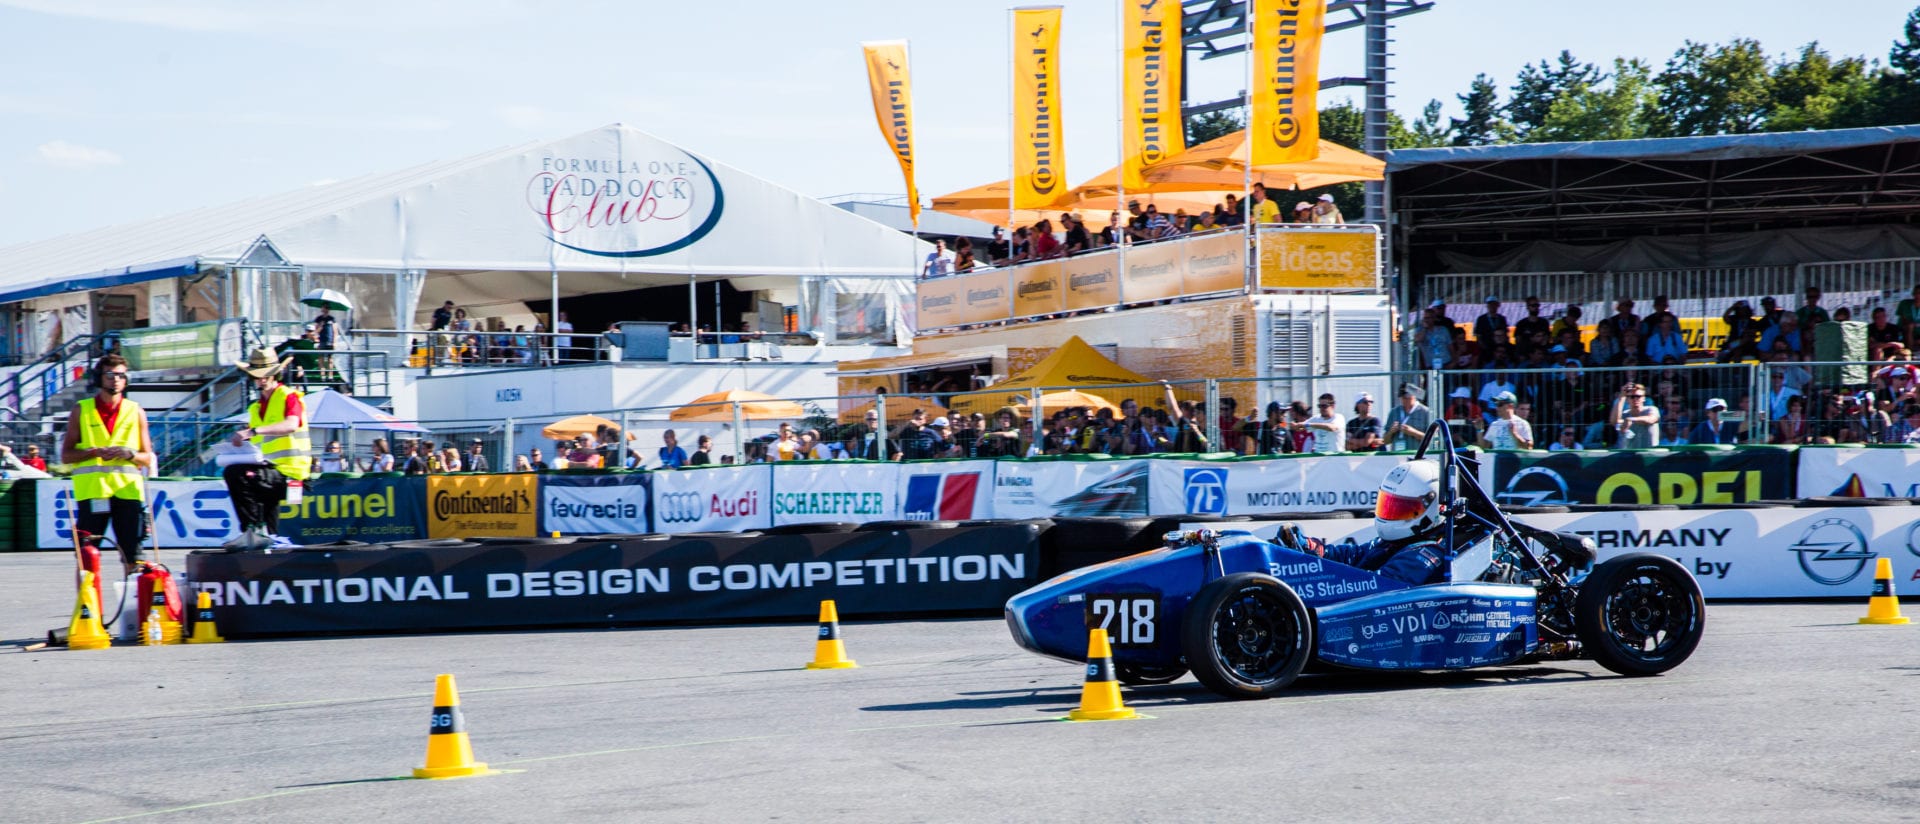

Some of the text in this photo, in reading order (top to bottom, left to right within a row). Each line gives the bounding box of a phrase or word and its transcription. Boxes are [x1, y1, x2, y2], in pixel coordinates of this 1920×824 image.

[1272, 0, 1301, 148] Continent
[1140, 20, 1166, 166] Continental
[1031, 48, 1057, 195] Continental
[543, 158, 687, 176] FORMULA ONE
[543, 177, 687, 199] PADDOCK
[526, 171, 695, 233] Club
[1279, 245, 1353, 272] ideas
[434, 489, 518, 522] Continental
[708, 490, 758, 517] Audi
[775, 491, 884, 515] SCHAEFFLER
[1247, 491, 1301, 507] MOTION
[1305, 491, 1337, 506] AND
[1562, 527, 1733, 549] RMANY
[487, 567, 670, 598] DESIGN
[688, 553, 1025, 592] COMPETITION
[1269, 559, 1323, 577] Brunel
[1699, 557, 1733, 579] by
[1318, 576, 1378, 597] Stralsund
[1093, 599, 1155, 643] 218
[1392, 613, 1427, 634] VDI
